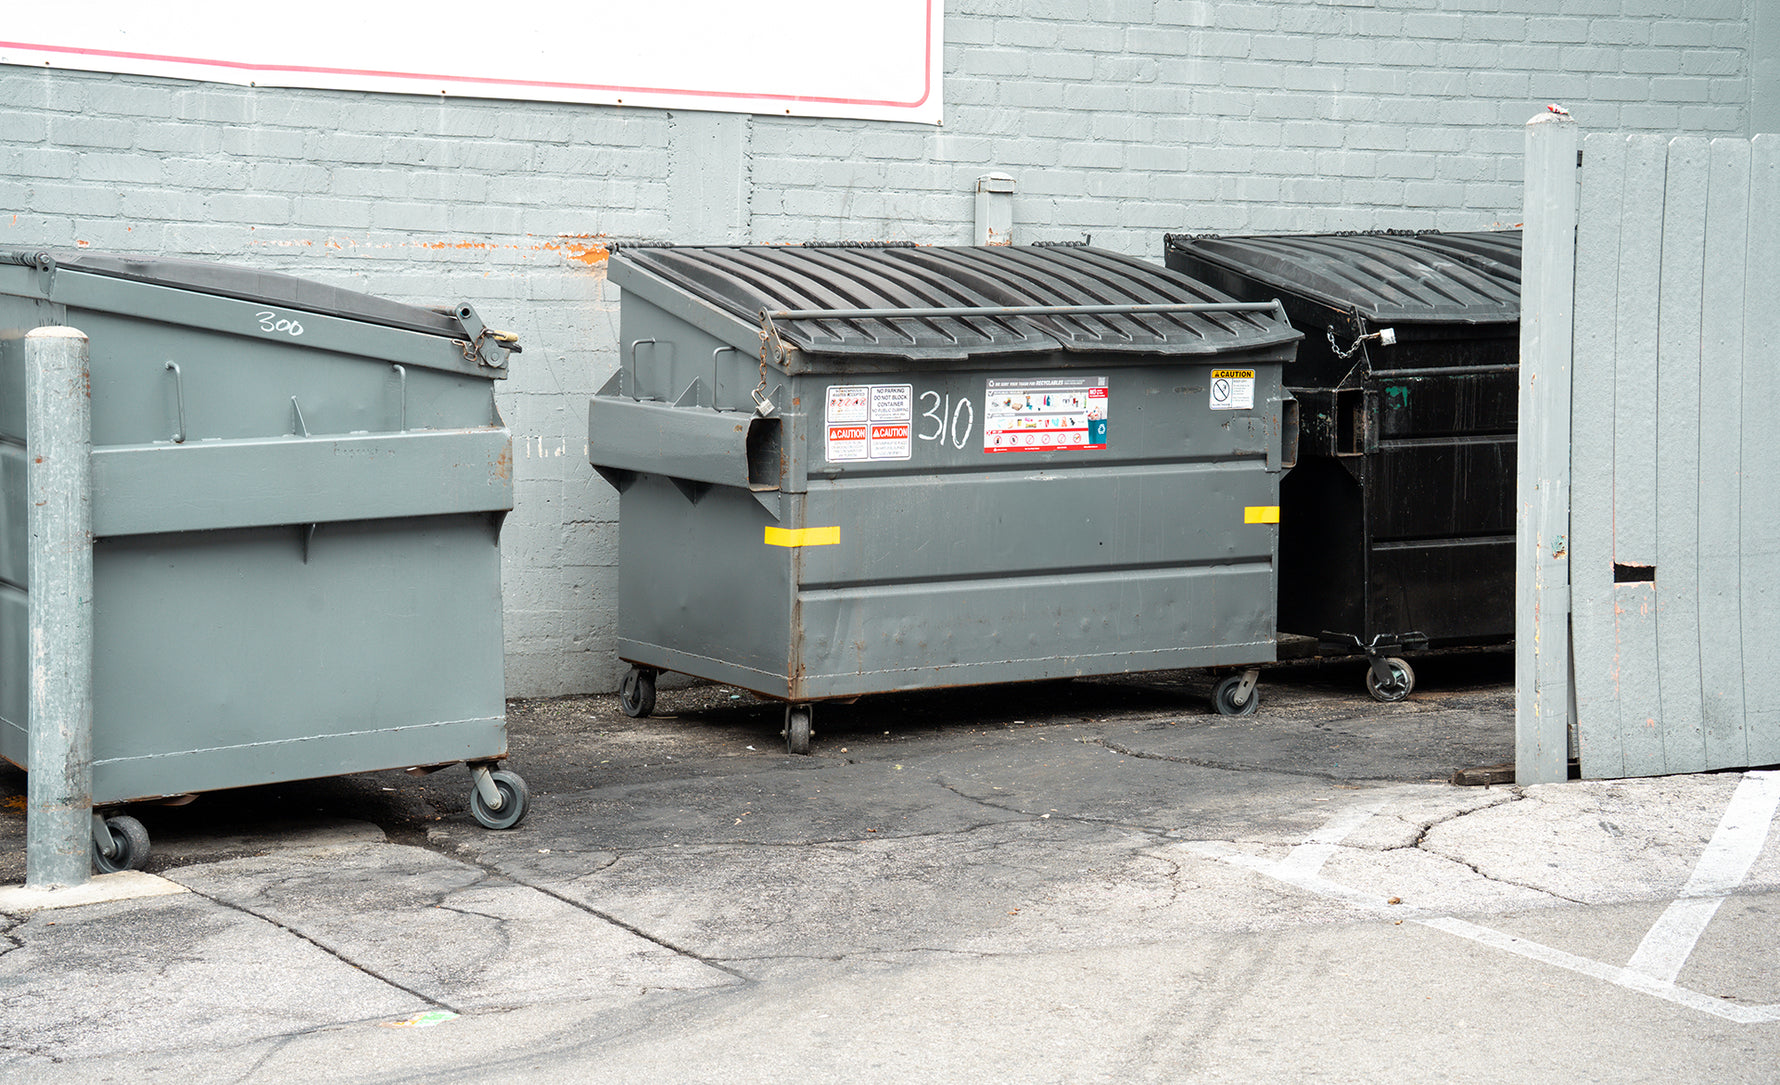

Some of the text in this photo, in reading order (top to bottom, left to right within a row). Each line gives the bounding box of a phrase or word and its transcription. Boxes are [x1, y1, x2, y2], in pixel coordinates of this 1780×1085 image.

[256, 311, 304, 336] 300
[918, 391, 973, 449] 310
[837, 429, 865, 438] CAUTION
[880, 428, 908, 437] CAUTION
